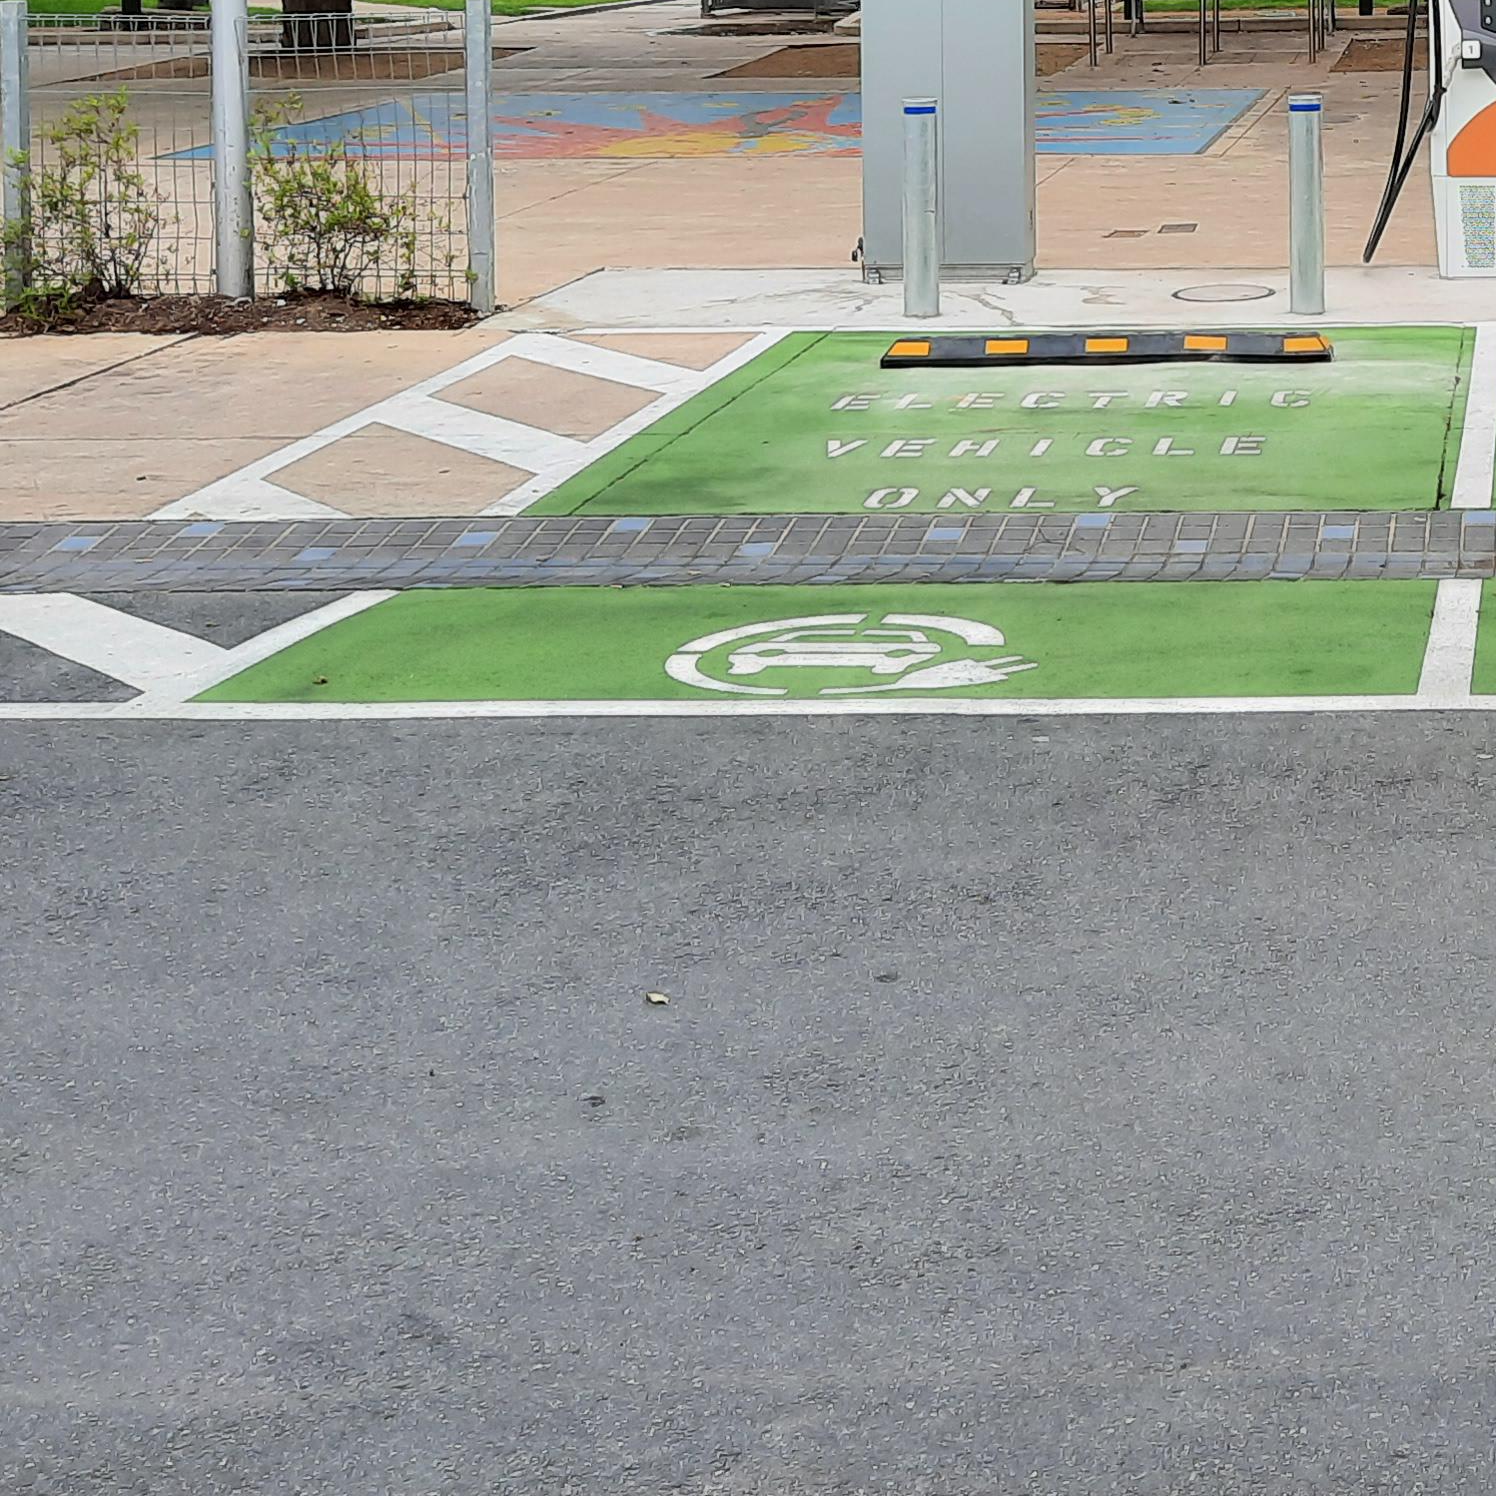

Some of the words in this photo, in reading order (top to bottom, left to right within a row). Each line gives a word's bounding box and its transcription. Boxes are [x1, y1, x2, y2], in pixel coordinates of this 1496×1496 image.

[1468, 45, 1474, 54] 1
[829, 390, 1310, 411] ELECTRIC
[825, 436, 1268, 459] VEHICLE
[860, 487, 1140, 510] ONLY
